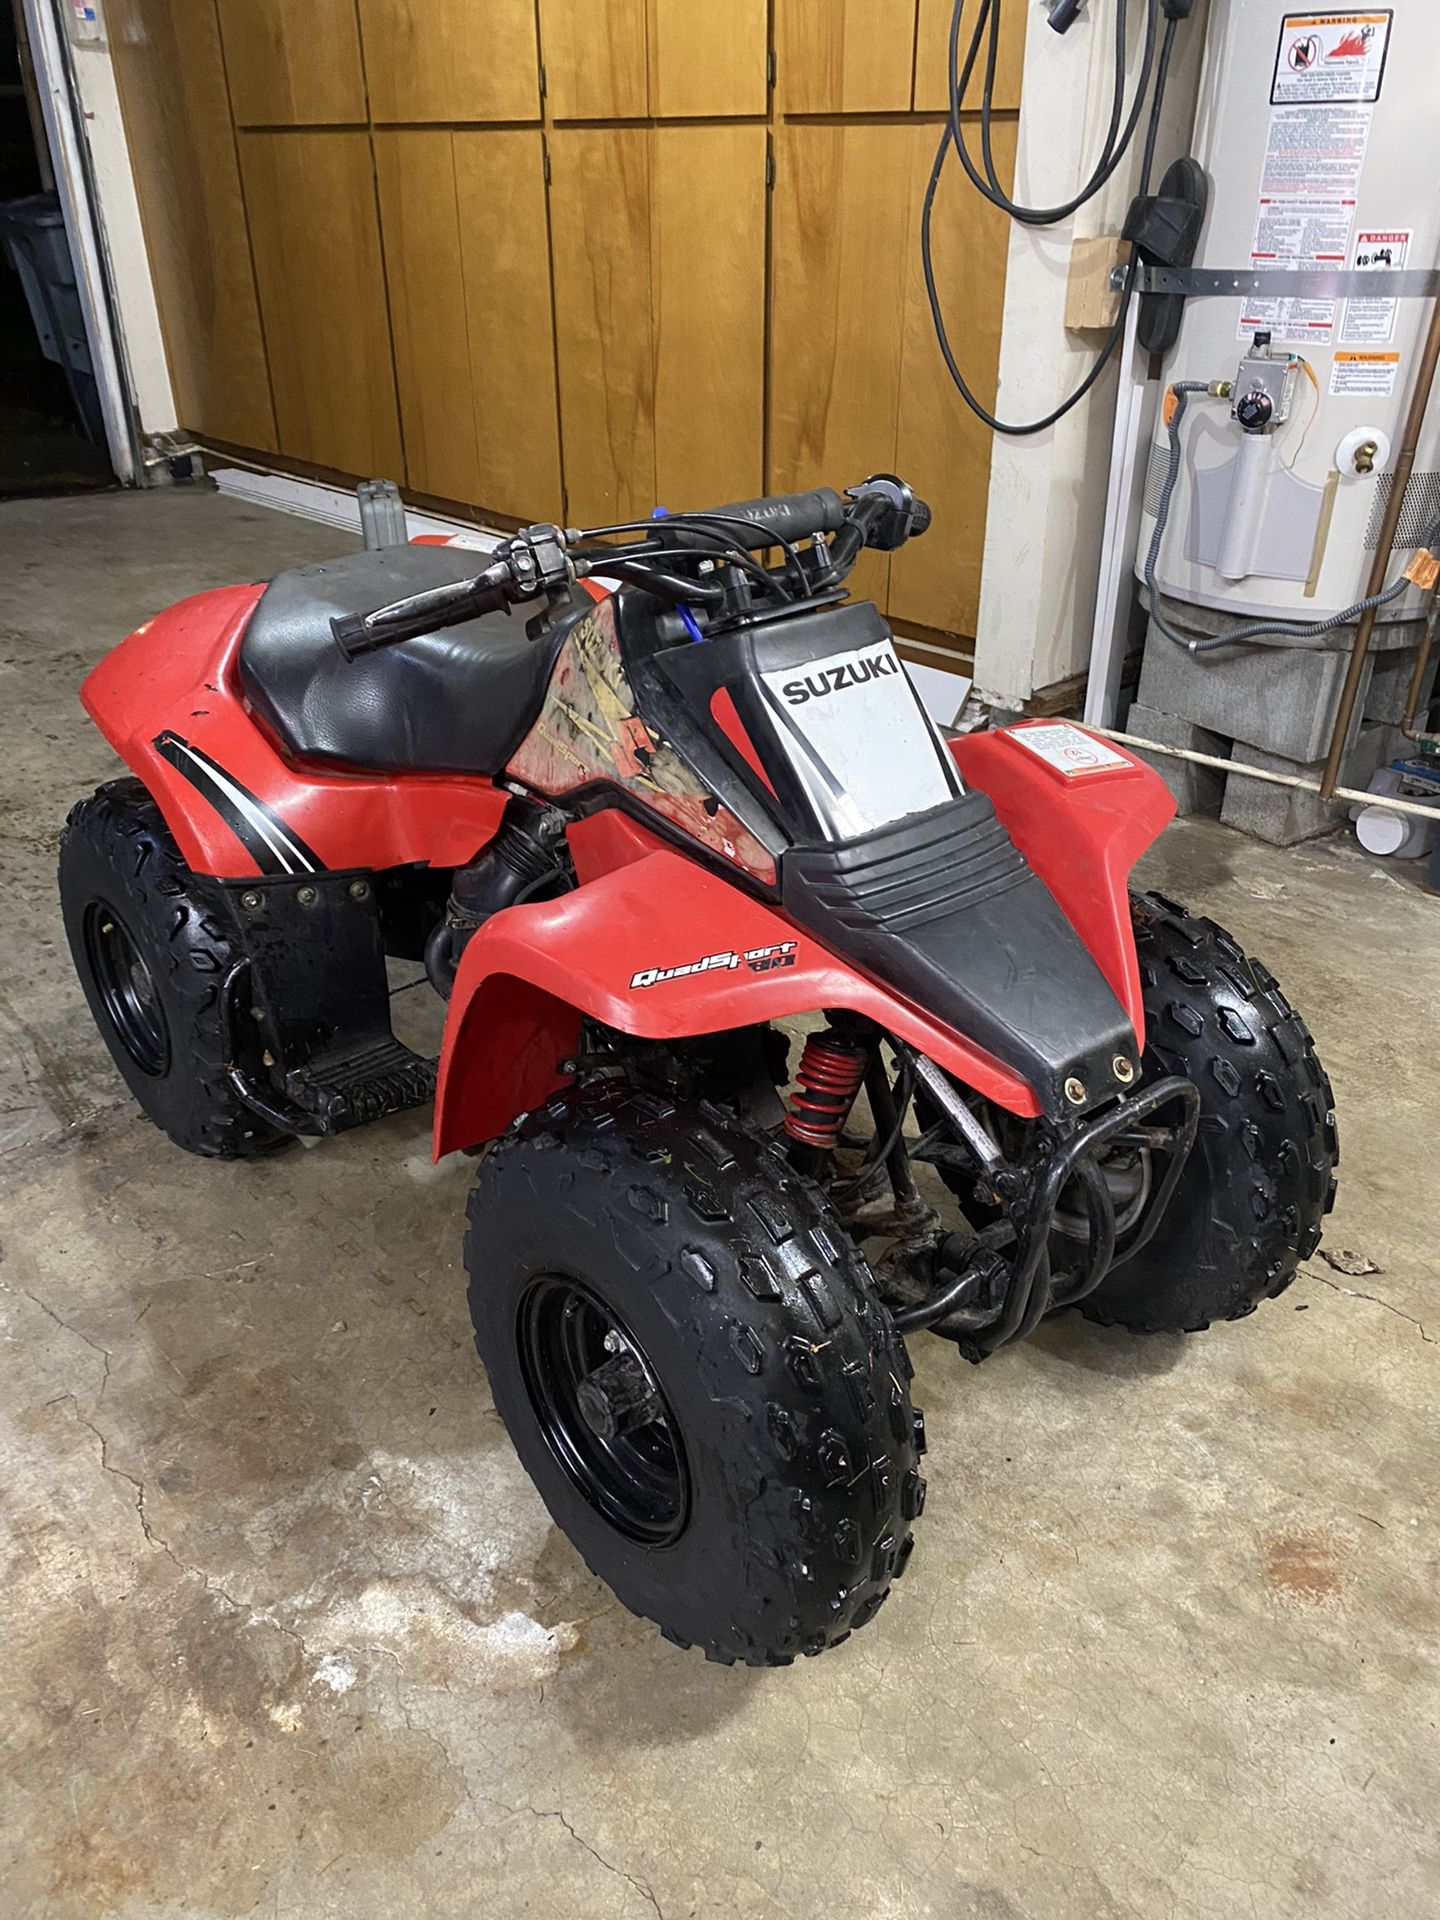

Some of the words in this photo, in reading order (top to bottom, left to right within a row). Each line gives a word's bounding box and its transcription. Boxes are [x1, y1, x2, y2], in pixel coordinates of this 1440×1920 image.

[1320, 17, 1358, 25] WARNING
[1370, 234, 1407, 242] DANGER
[782, 653, 899, 706] SUZUKI
